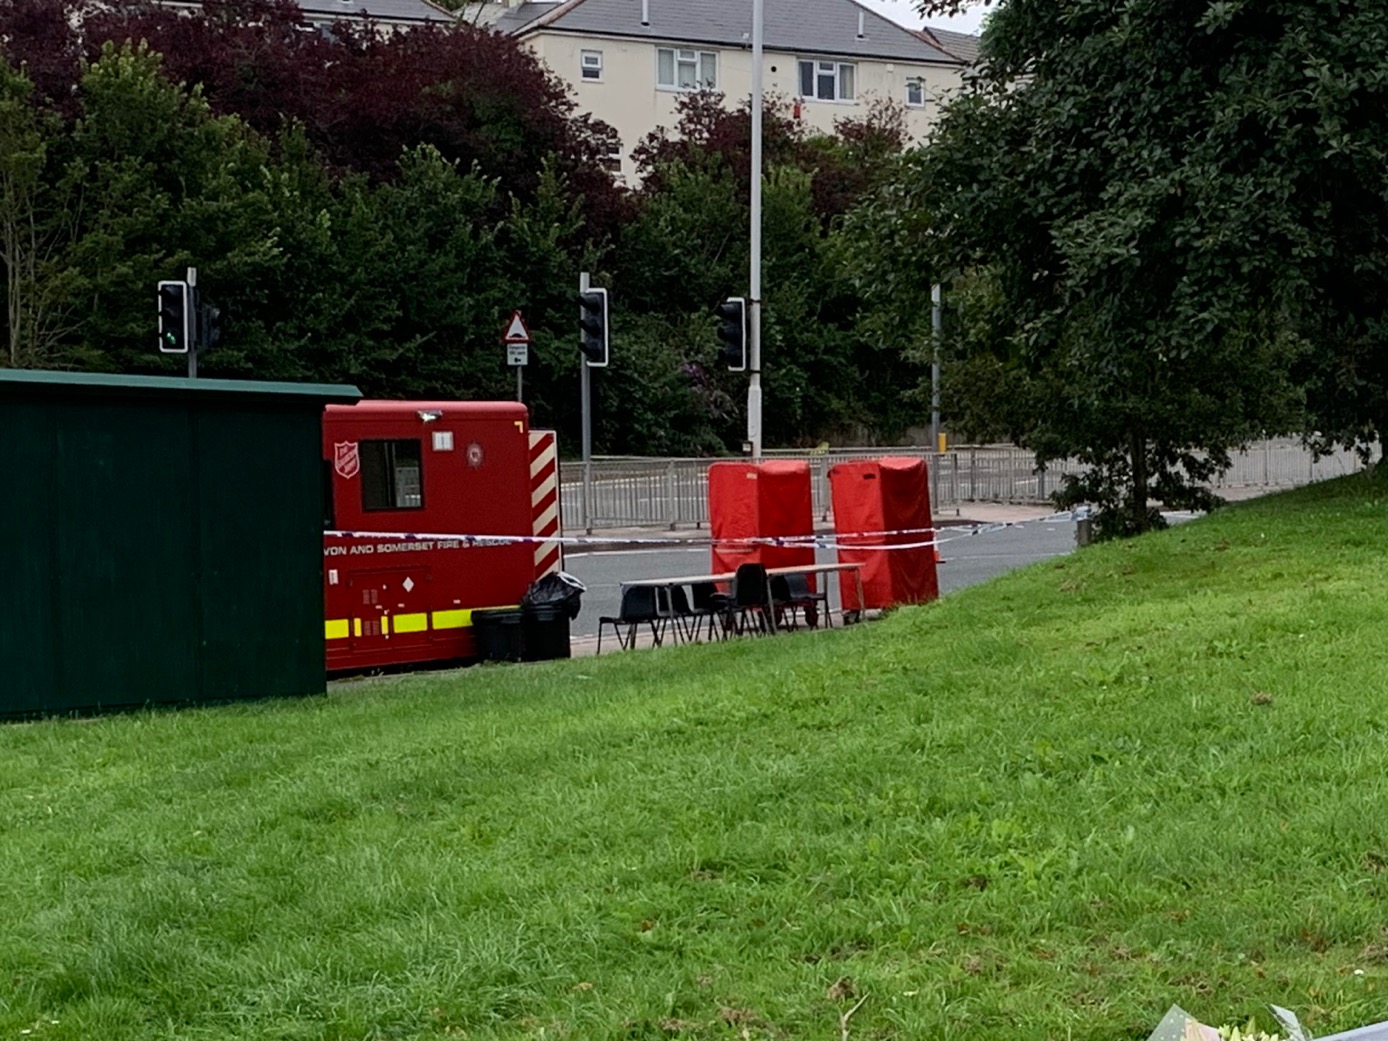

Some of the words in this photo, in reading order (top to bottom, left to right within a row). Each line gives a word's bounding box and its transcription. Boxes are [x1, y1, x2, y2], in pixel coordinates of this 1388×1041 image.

[350, 544, 374, 555] AND
[377, 541, 434, 553] SOMERSET
[437, 540, 460, 549] FIRE
